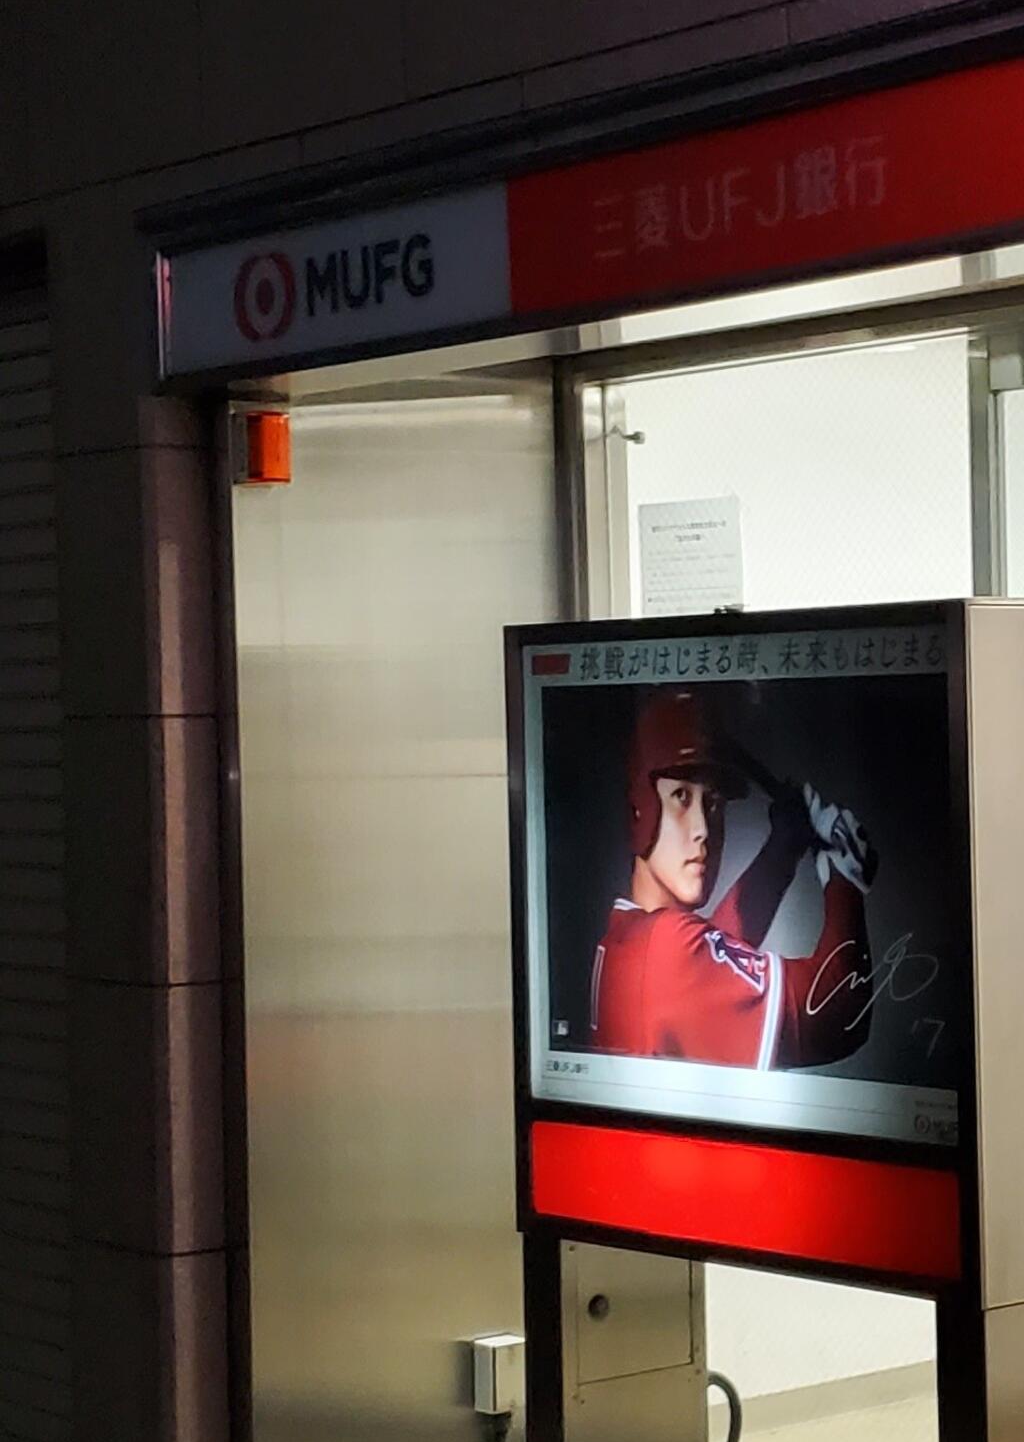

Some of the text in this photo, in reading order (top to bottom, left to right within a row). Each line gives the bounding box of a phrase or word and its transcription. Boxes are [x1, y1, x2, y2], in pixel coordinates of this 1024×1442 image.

[594, 134, 888, 259] 三菱UFJ銀行
[304, 233, 435, 318] MUFG
